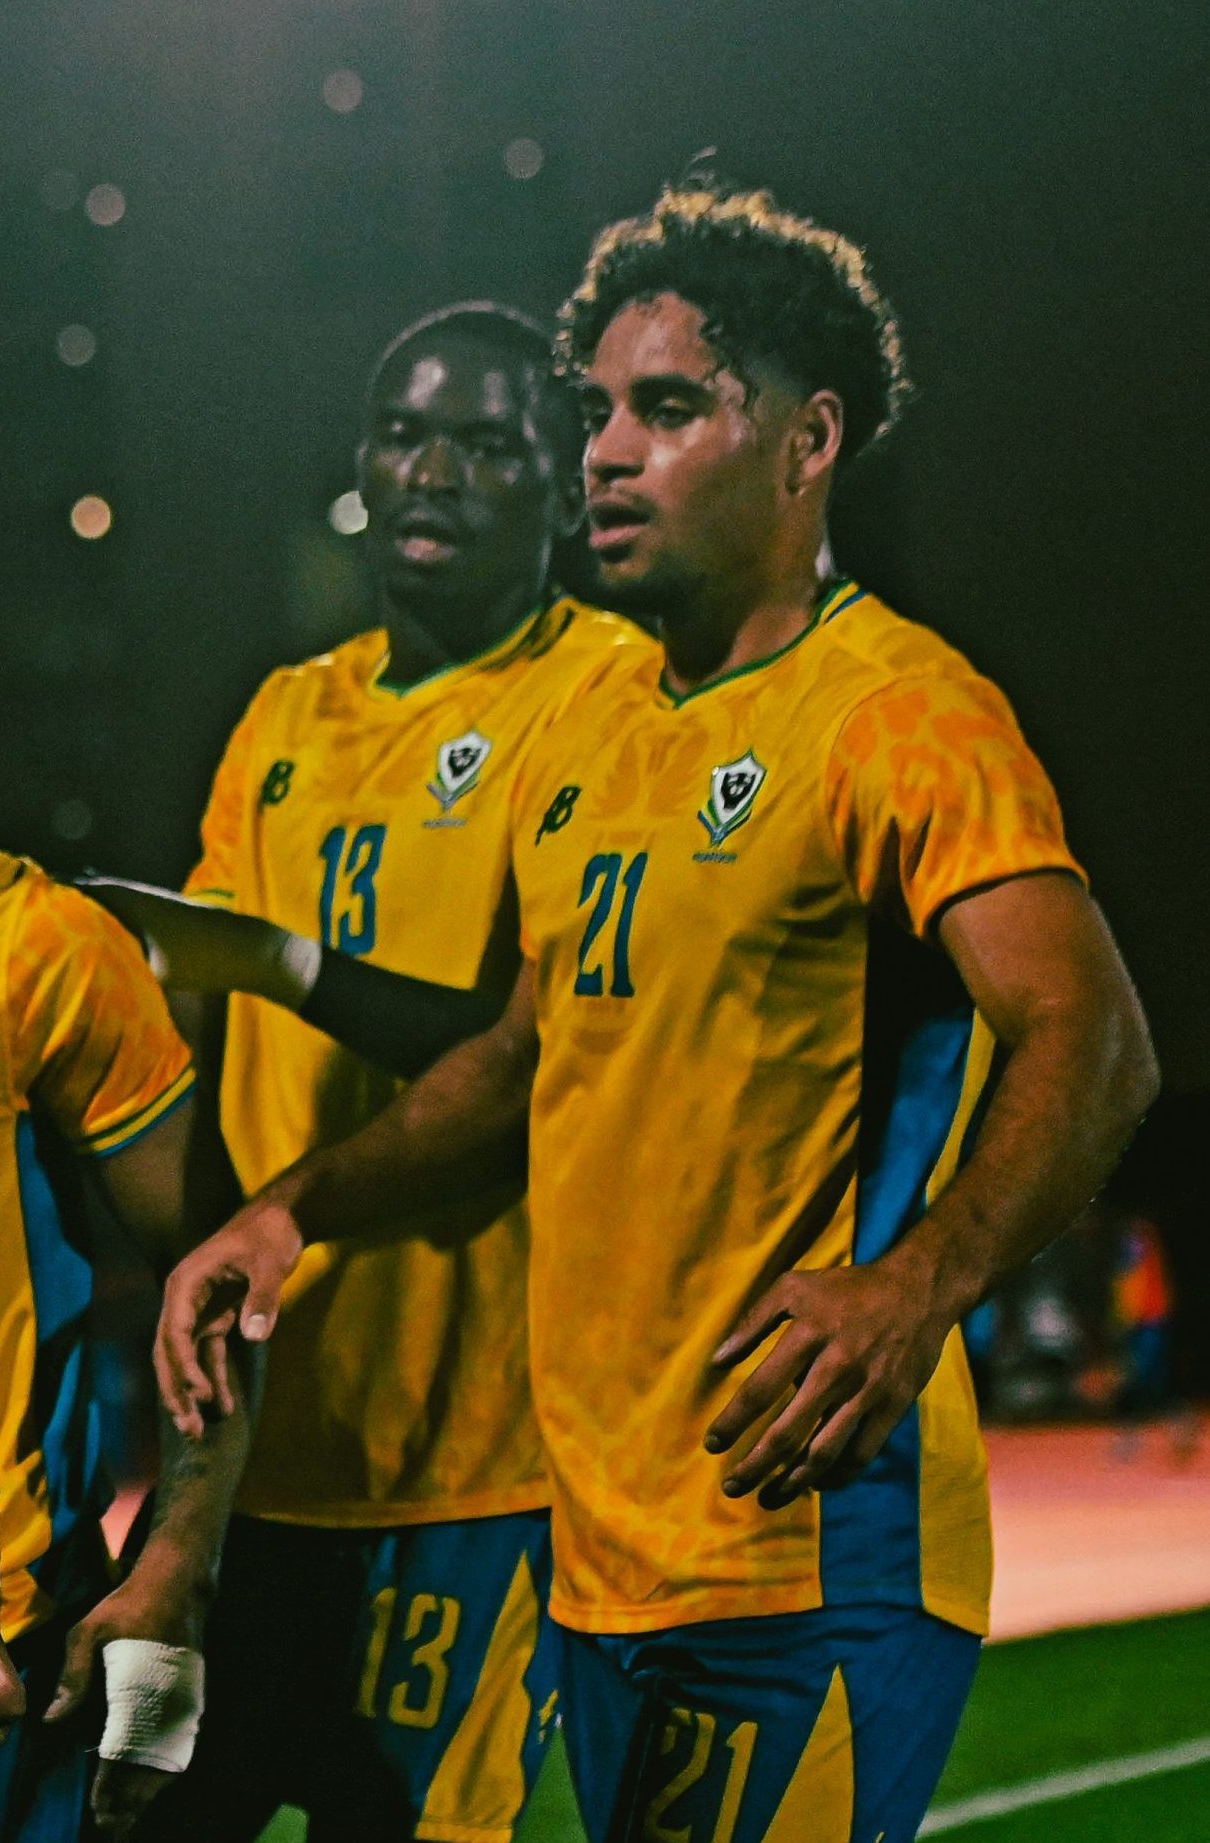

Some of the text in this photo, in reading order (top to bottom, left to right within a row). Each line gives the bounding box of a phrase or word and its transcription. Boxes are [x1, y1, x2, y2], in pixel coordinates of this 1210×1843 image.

[319, 823, 387, 955] 13
[574, 851, 648, 998] 21
[357, 1586, 462, 1730] 13
[645, 1707, 758, 1843] 21
